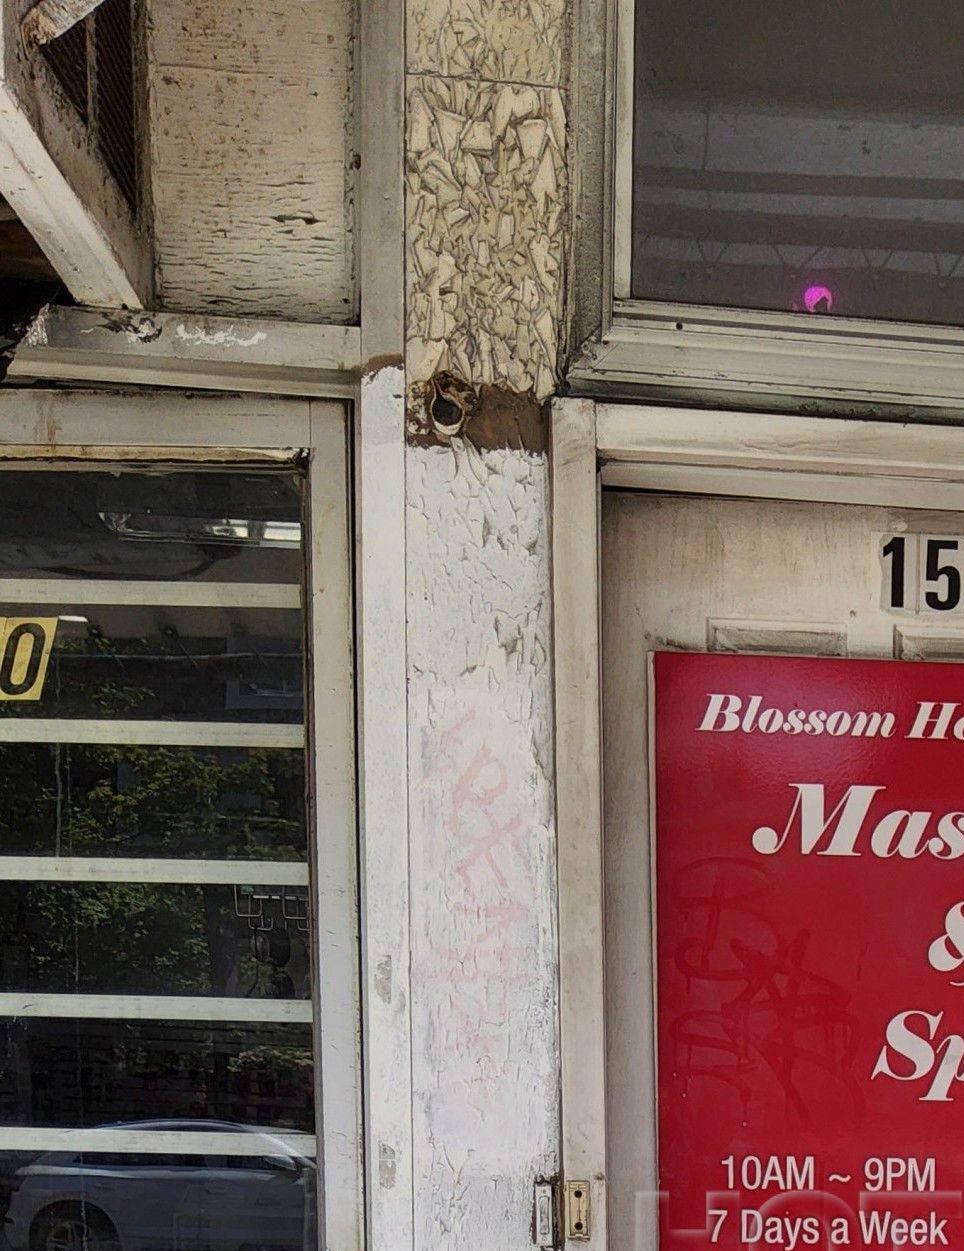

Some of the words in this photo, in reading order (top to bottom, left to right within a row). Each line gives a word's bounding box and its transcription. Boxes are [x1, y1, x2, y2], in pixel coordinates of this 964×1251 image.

[696, 693, 896, 739] Blossom
[721, 1155, 816, 1191] 10AM
[864, 1157, 936, 1192] 9PM
[708, 1209, 728, 1243] 7
[741, 1210, 820, 1251] Days
[831, 1219, 851, 1245] a
[858, 1211, 950, 1247] Week
